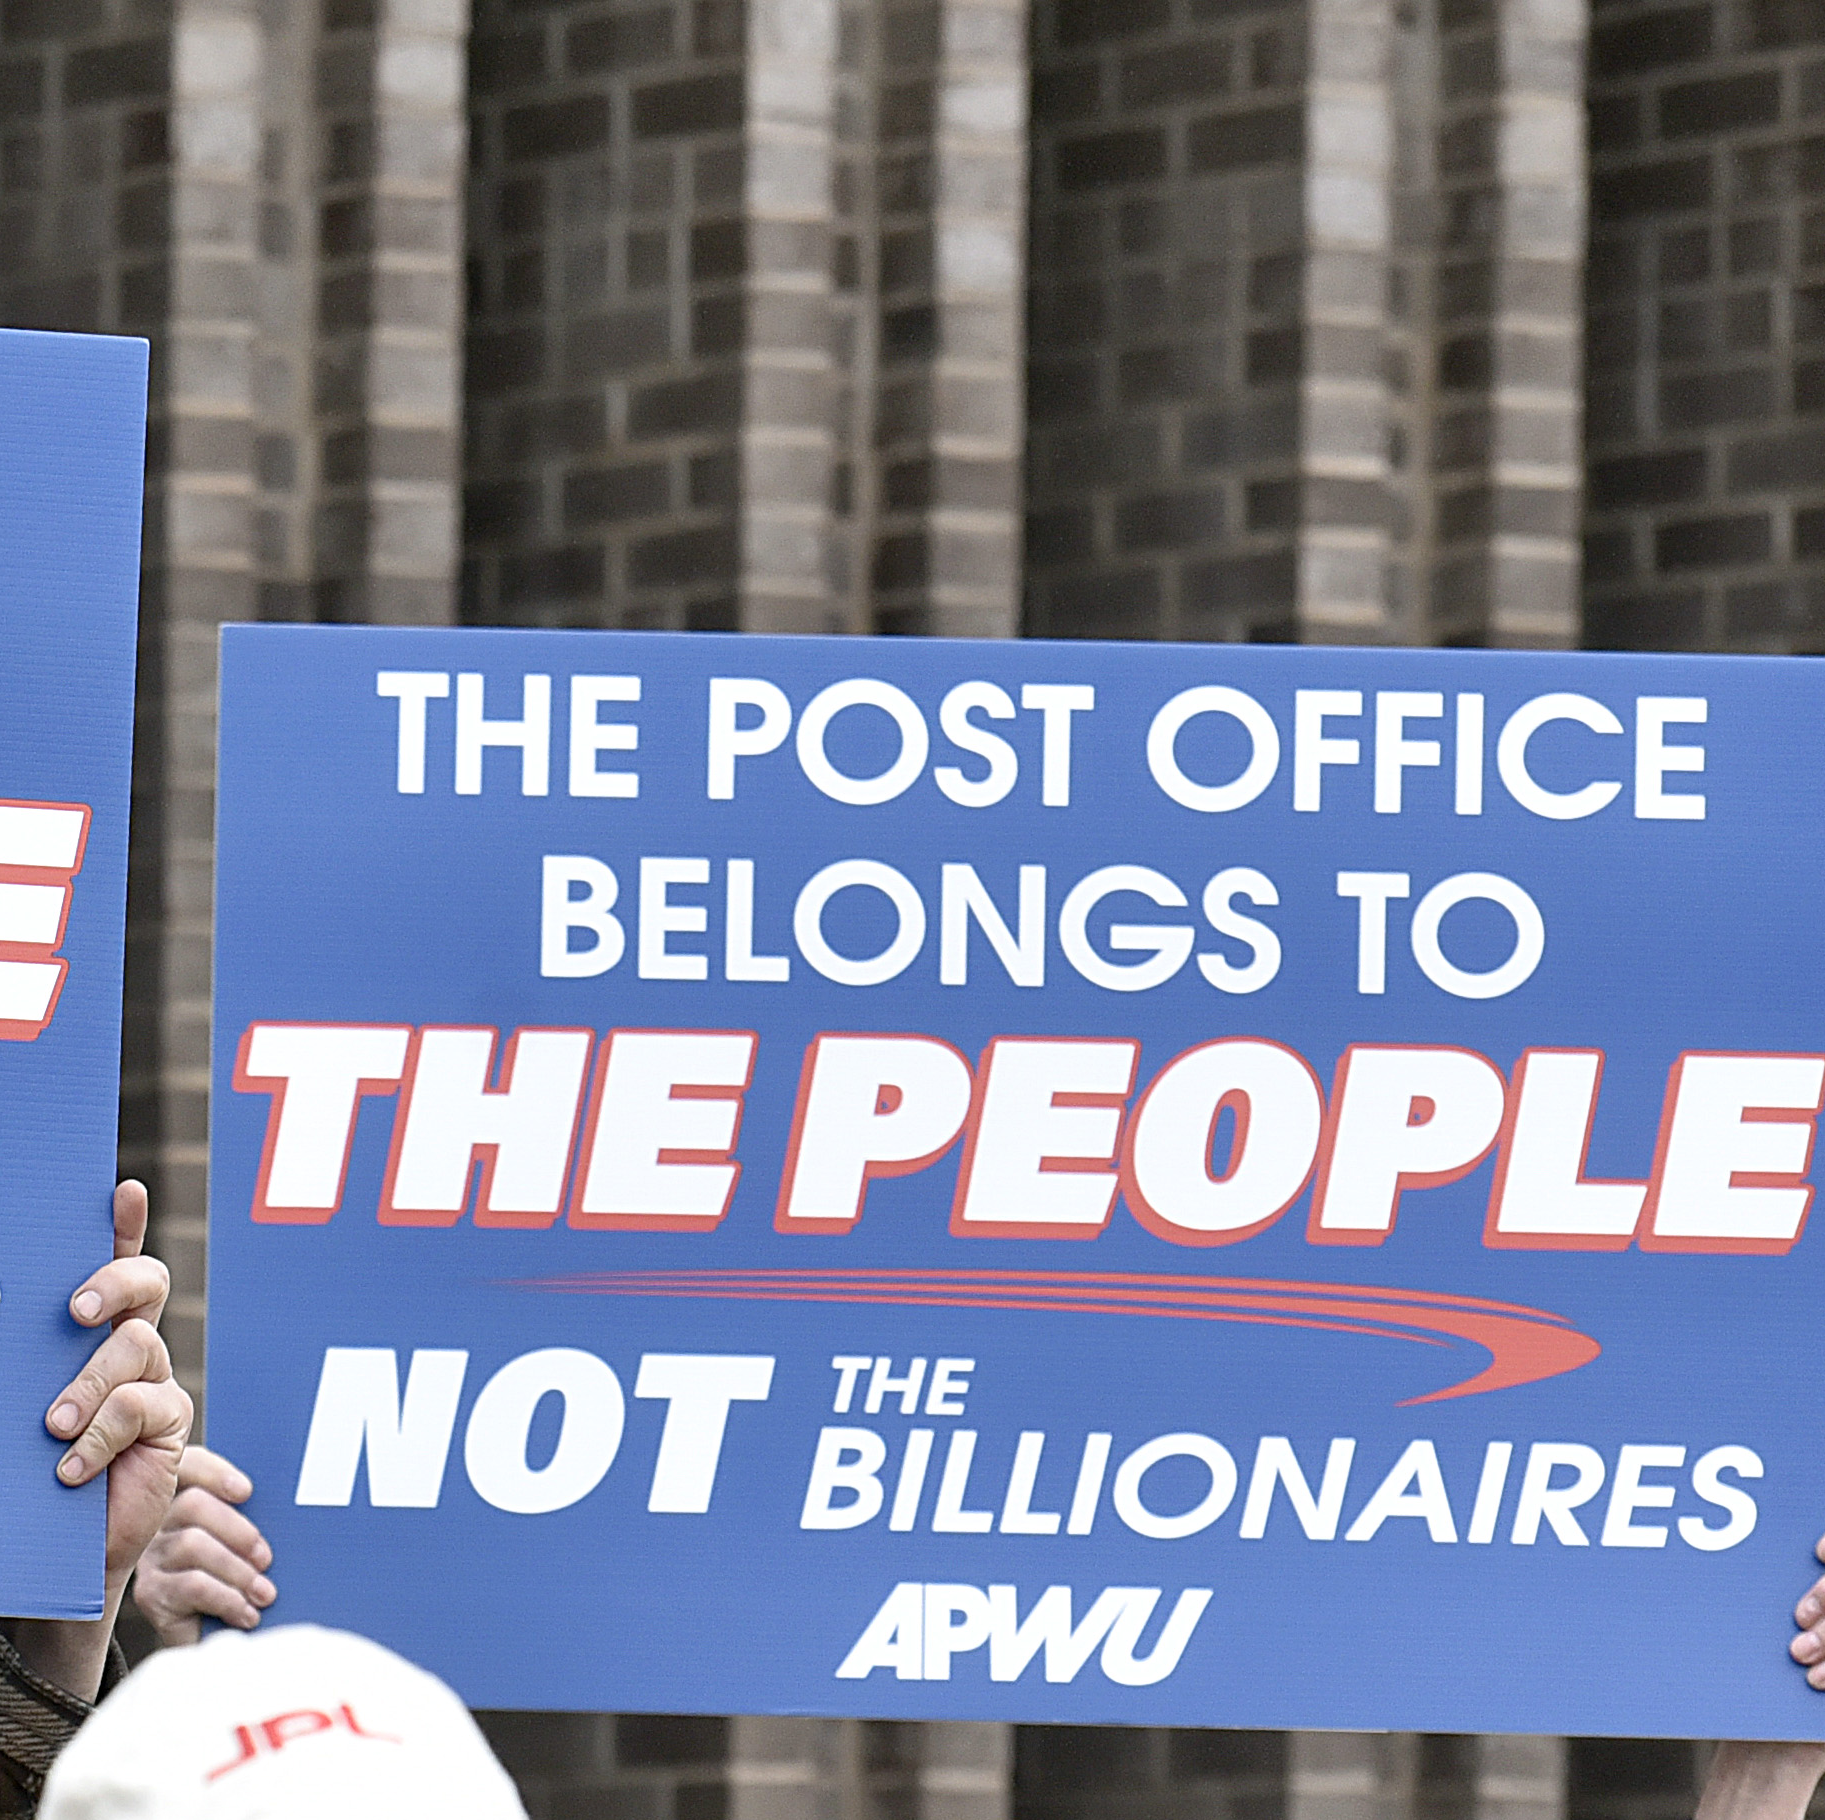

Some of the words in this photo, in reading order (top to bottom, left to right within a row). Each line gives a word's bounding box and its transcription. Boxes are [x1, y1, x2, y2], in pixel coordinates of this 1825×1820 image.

[377, 672, 641, 797] THE
[708, 678, 1094, 807] POST
[1147, 686, 1707, 819] OFFICE
[541, 856, 1281, 993] BELONGS
[1337, 872, 1544, 998] TO
[233, 1022, 759, 1232] THE
[775, 1032, 1825, 1255] PEOPLE
[296, 1348, 775, 1513] NOT
[833, 1357, 975, 1415] THE
[800, 1427, 1763, 1551] BILLIONAIRES
[836, 1583, 1213, 1685] APWU
[206, 1702, 401, 1783] JPL
